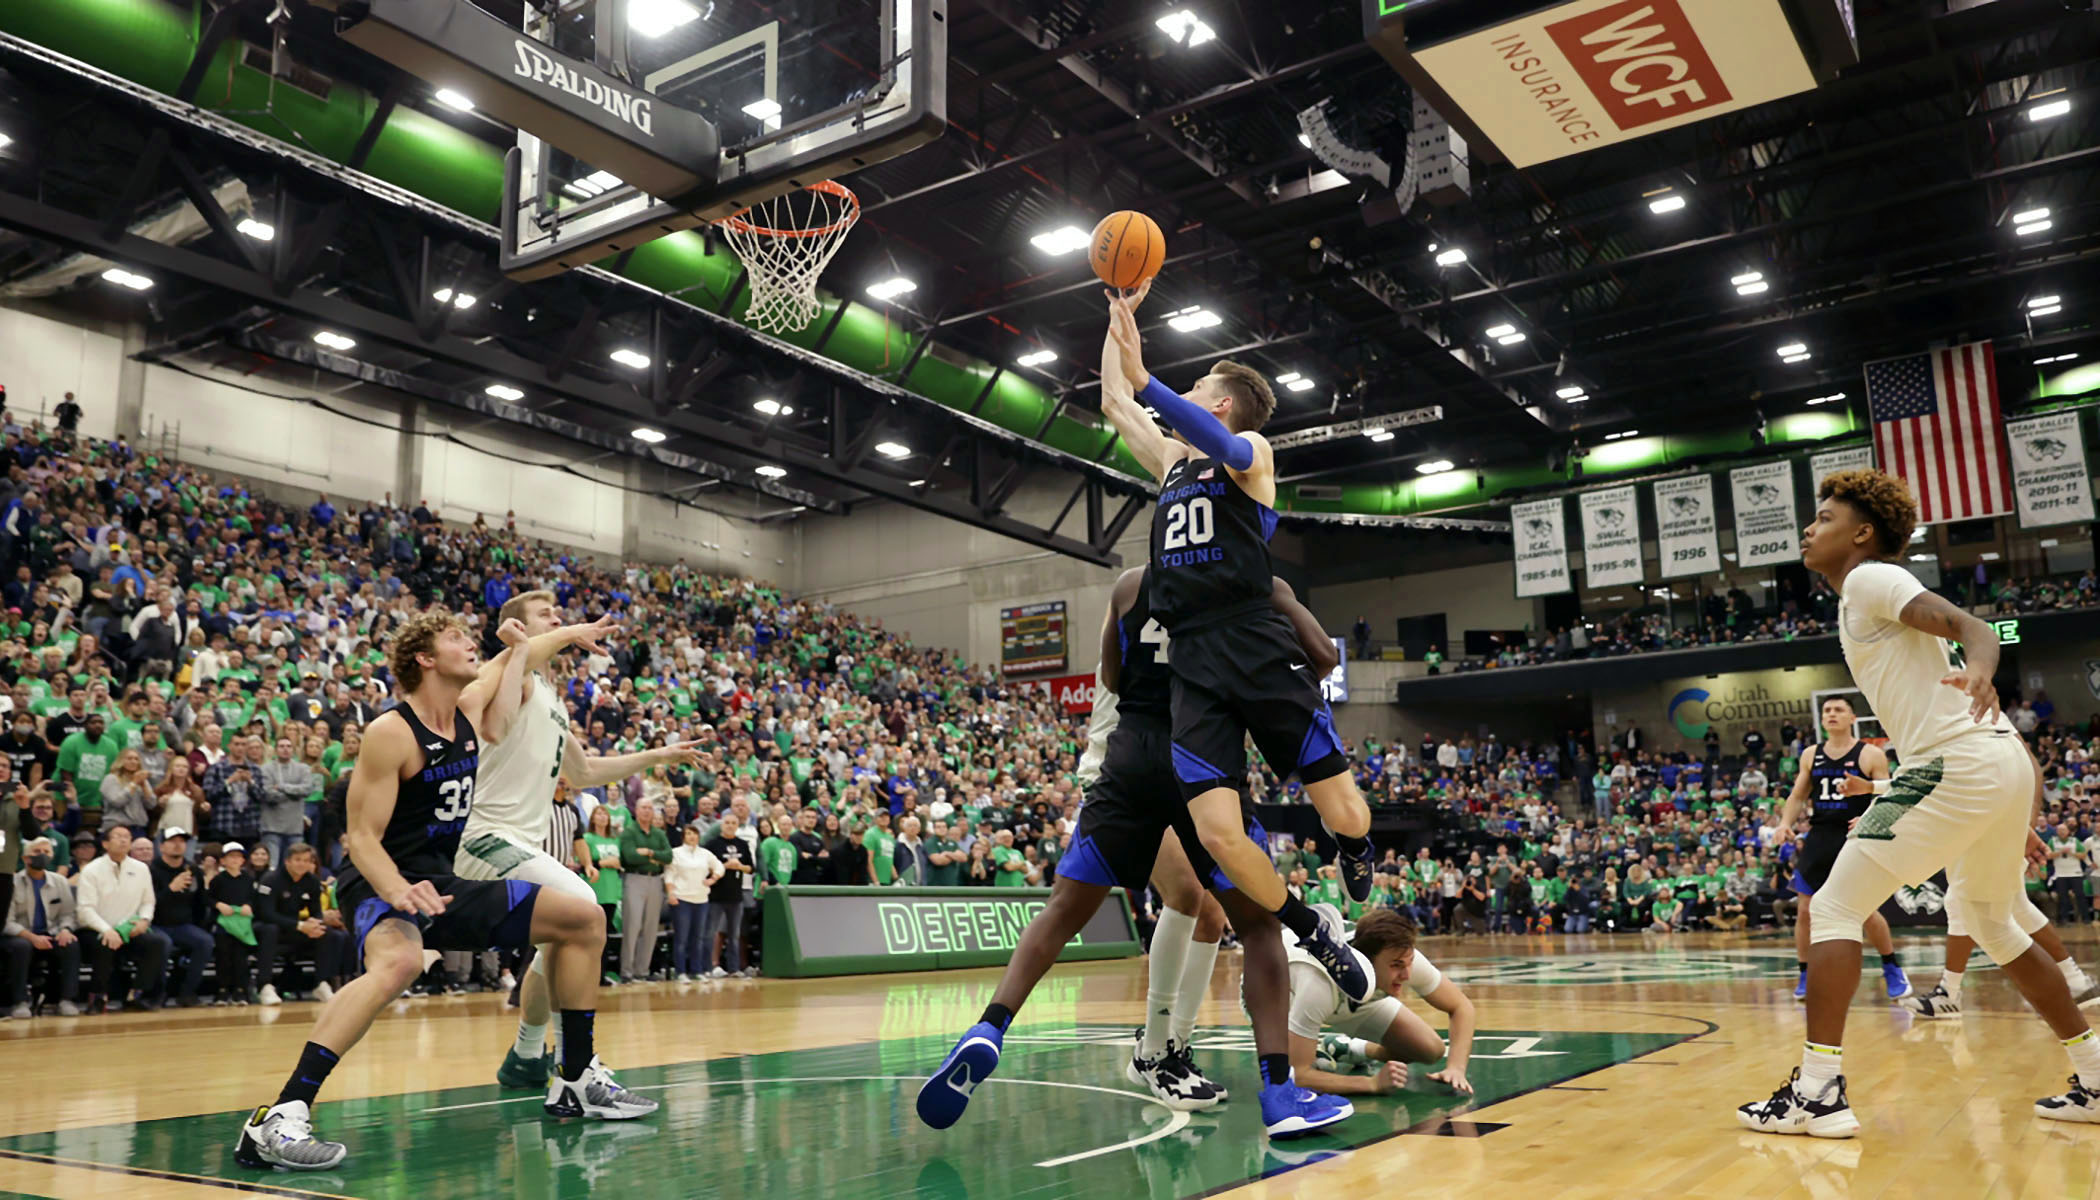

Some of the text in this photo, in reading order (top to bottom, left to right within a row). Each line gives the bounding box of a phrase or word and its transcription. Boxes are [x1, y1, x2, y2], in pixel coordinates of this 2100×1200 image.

[1579, 5, 1708, 109] WCF
[514, 39, 652, 135] SPALDING
[1490, 33, 1601, 145] INSURANCE
[2009, 423, 2036, 433] UTAH
[2038, 417, 2075, 428] VALLEY
[1732, 469, 1754, 479] UTAH
[1757, 464, 1788, 475] VALLEY
[2017, 469, 2085, 487] CHAMPIONS
[1679, 477, 1709, 488] VALLEY
[2029, 482, 2077, 498] 2010-11
[1158, 482, 1226, 506] BRIGHAM
[2031, 496, 2080, 511] 2011-12
[1164, 497, 1215, 551] 20
[1738, 523, 1795, 538] CHAMPIONS
[1596, 529, 1627, 540] SWAC
[1661, 525, 1714, 540] CHAMPIONS
[1529, 540, 1551, 551] ICAC
[1586, 537, 1638, 551] CHAMPIONS
[1750, 540, 1789, 556] 2004
[1160, 547, 1224, 569] YOUNG
[1672, 546, 1707, 561] 1996
[1592, 558, 1637, 573] 1995-96
[1521, 567, 1564, 582] 1985-86
[1723, 684, 1771, 703] Utah
[1819, 777, 1846, 801] 13
[434, 775, 473, 821] 33
[878, 902, 1083, 955] DEFEN
